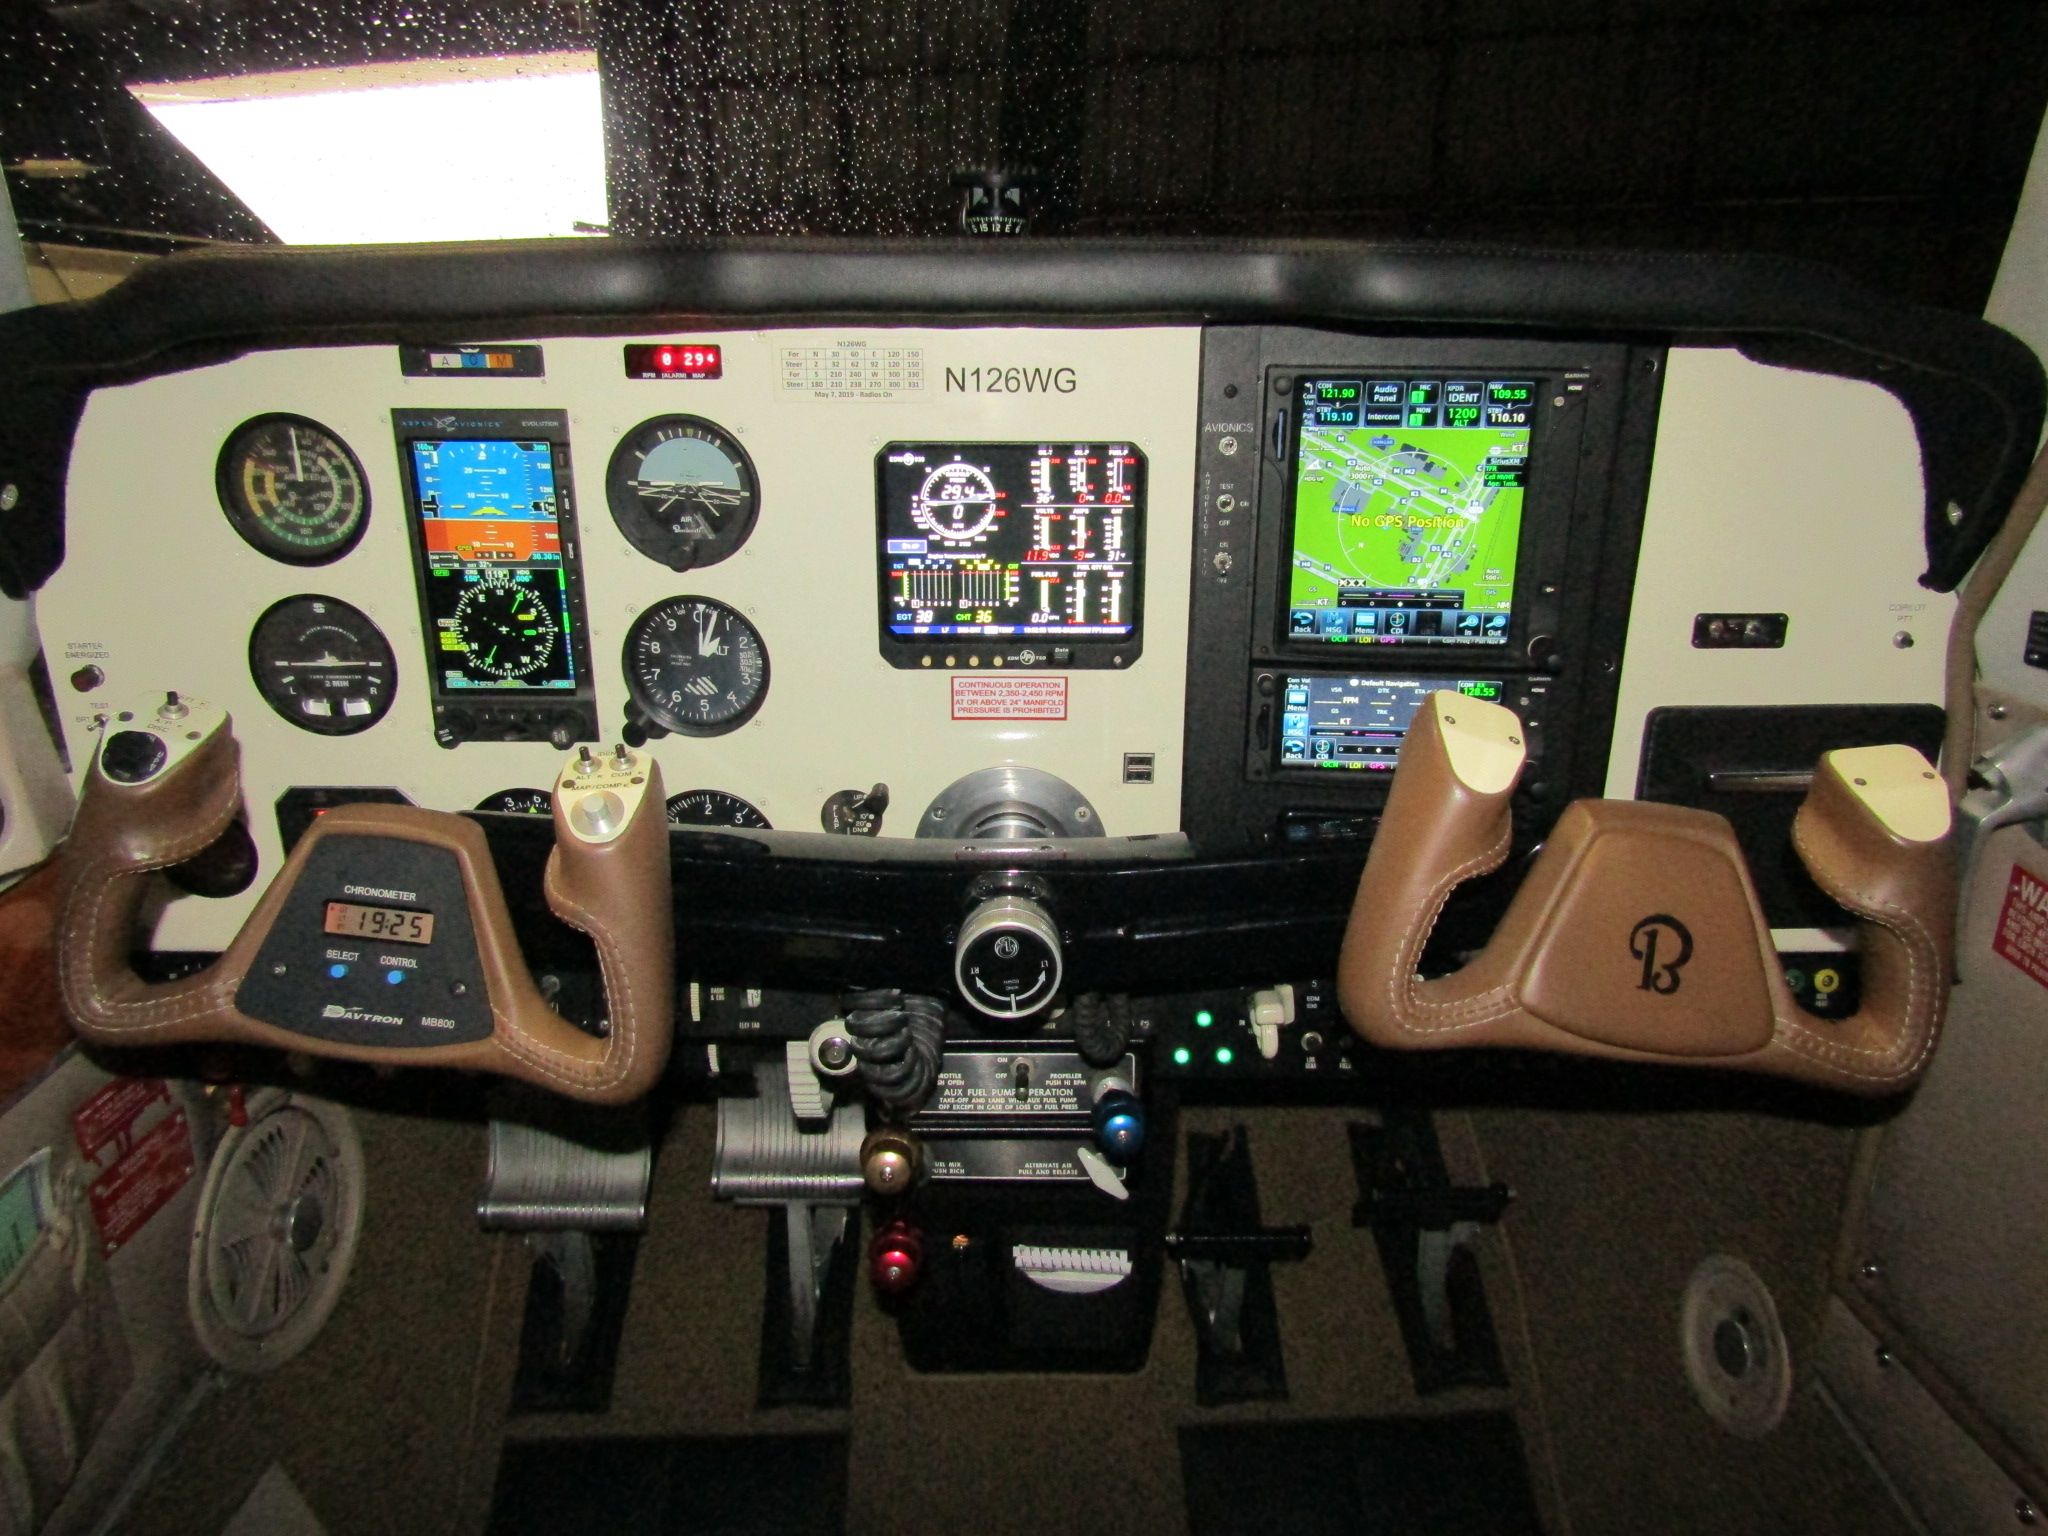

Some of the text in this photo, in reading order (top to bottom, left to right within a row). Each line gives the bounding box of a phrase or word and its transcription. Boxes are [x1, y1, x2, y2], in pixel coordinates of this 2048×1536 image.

[441, 356, 449, 366] A
[945, 367, 1077, 393] N126WG
[1321, 389, 1355, 399] 121.90
[1374, 385, 1398, 394] Audio
[1493, 390, 1527, 399] 109.55
[1374, 394, 1397, 402] Panel
[1448, 393, 1479, 403] IDENT
[1320, 412, 1353, 422] 119.10
[1367, 412, 1400, 421] Intercom
[1448, 408, 1477, 419] 1200
[1490, 413, 1526, 423] 110.10
[1204, 422, 1254, 433] AVIONICS
[941, 485, 975, 499] 29.4
[953, 505, 964, 519] 0
[1352, 515, 1464, 528] No GPS Position
[976, 610, 992, 623] 36
[667, 619, 677, 631] 9
[739, 637, 748, 649] 2
[1380, 636, 1396, 644] GPS
[651, 642, 661, 653] 8
[651, 669, 661, 680] 7
[741, 673, 750, 685] 3
[1362, 679, 1420, 688] Default Navigation
[290, 687, 296, 695] L
[370, 687, 377, 695] R
[672, 691, 682, 702] 6
[1464, 687, 1495, 697] 128.55
[727, 691, 736, 703] 4
[700, 700, 710, 711] 5
[505, 797, 514, 807] 3
[705, 804, 712, 815] 2
[735, 813, 743, 824] 3
[344, 885, 416, 902] CHRONOMETER
[358, 911, 423, 939] 19:25
[326, 949, 360, 961] SELECT
[380, 955, 418, 969] CONTROL
[421, 1016, 455, 1029] MB800
